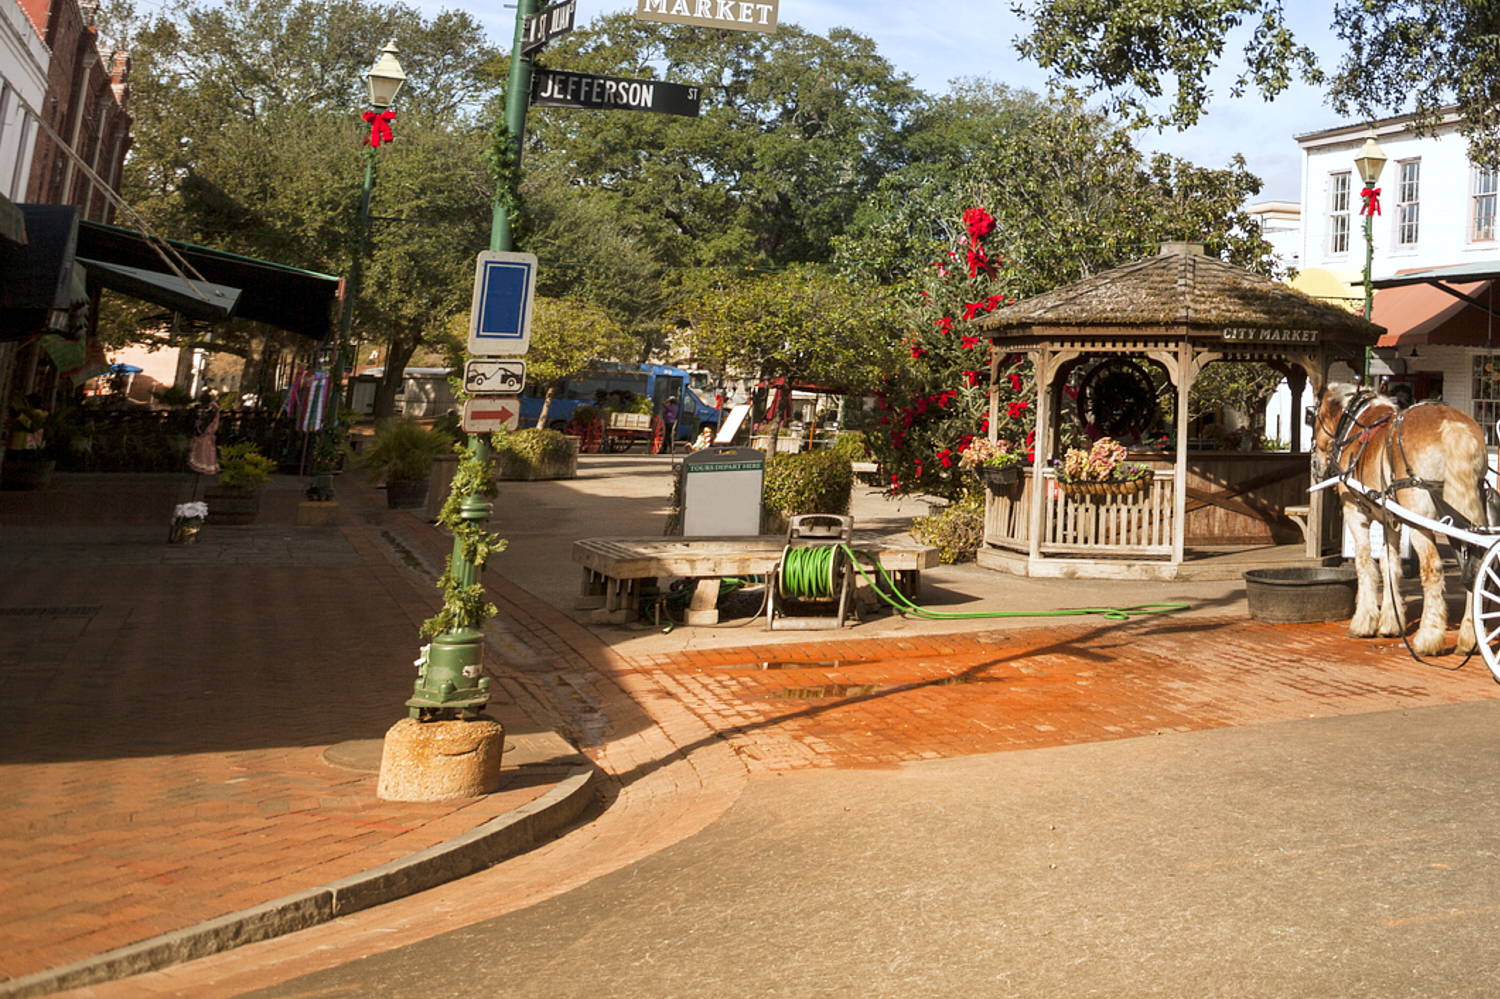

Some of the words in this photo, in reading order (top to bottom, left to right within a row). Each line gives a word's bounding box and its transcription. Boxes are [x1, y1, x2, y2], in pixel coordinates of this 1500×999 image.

[540, 74, 654, 108] JEFFERSON
[687, 87, 699, 100] ST
[1223, 327, 1257, 339] CITY
[1259, 328, 1319, 342] MARKET
[715, 463, 741, 471] DEPART
